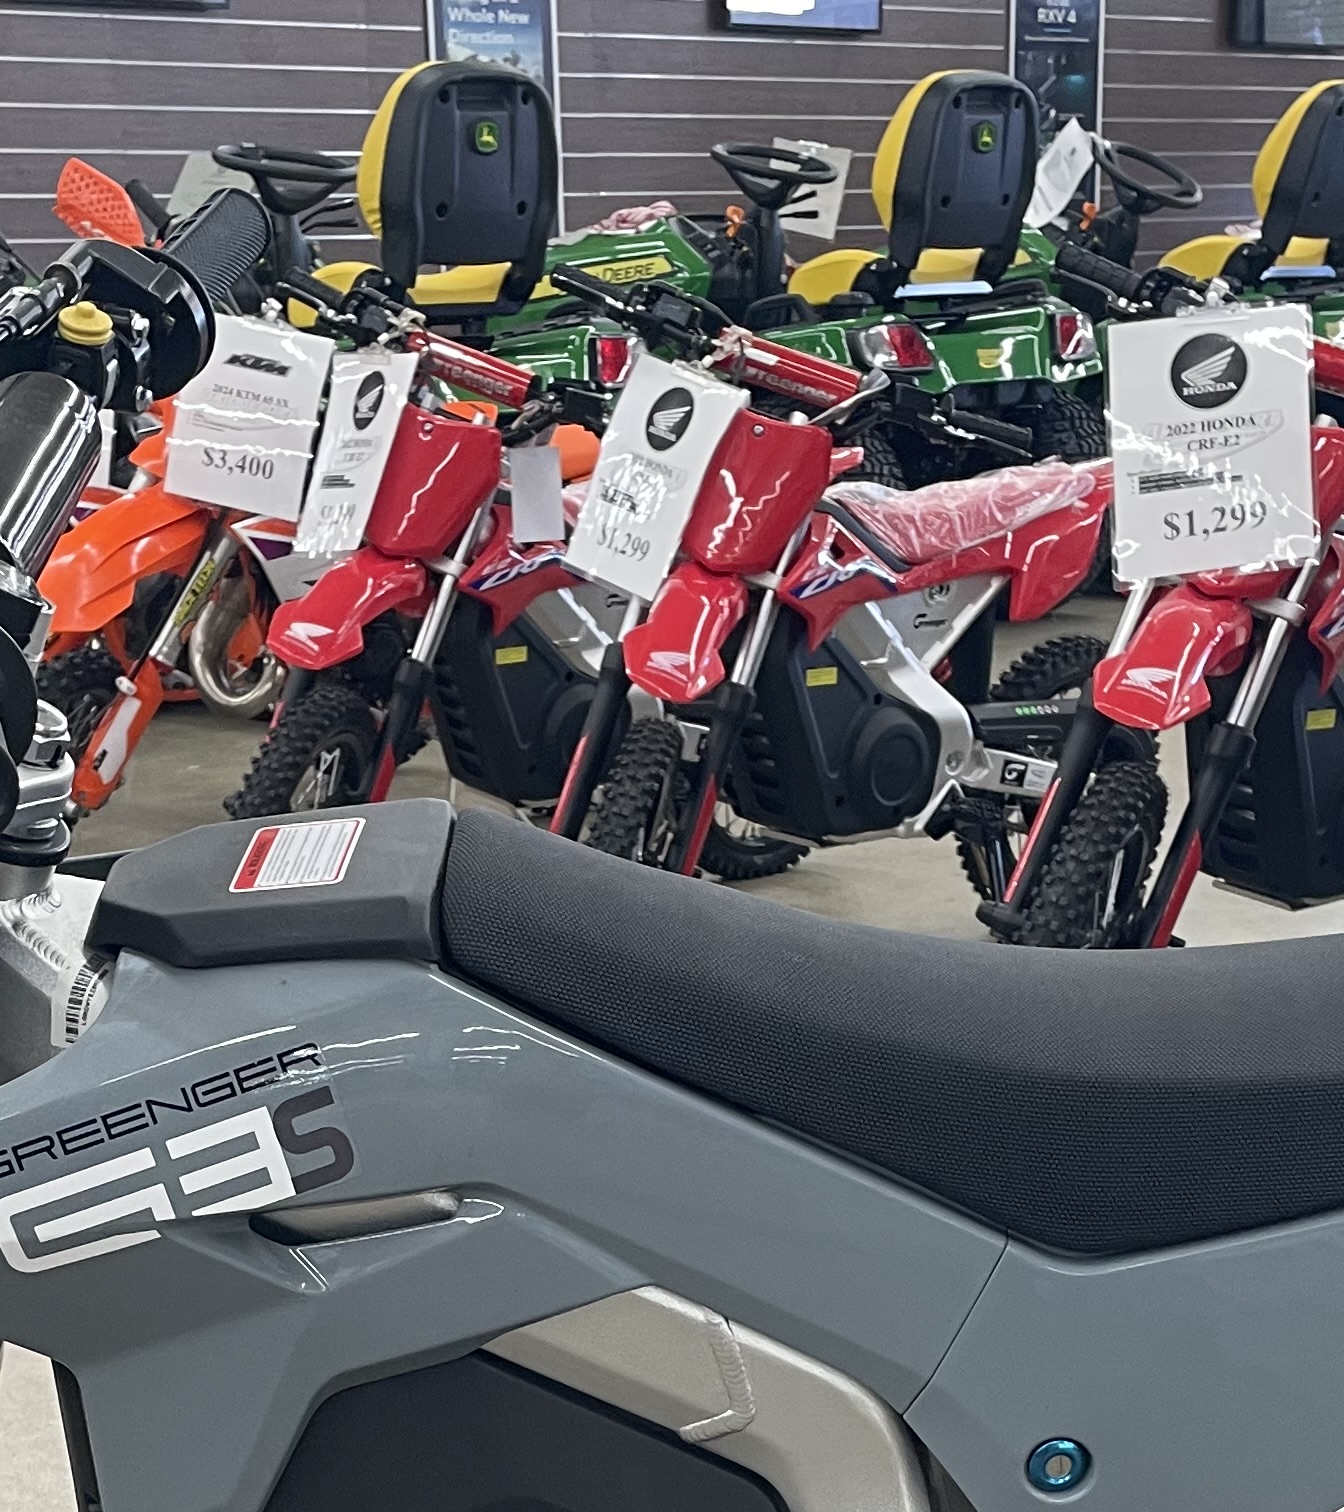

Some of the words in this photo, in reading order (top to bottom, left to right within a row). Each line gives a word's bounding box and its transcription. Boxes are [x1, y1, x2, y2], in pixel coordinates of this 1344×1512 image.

[498, 8, 531, 25] New
[602, 262, 656, 282] DEERE
[223, 354, 293, 377] KTM
[1182, 381, 1238, 396] HONDA
[1166, 422, 1197, 438] 2022
[1200, 416, 1258, 434] HONDA
[201, 446, 275, 480] $3,400
[1163, 500, 1267, 541] $1,299
[597, 524, 651, 562] $1,299
